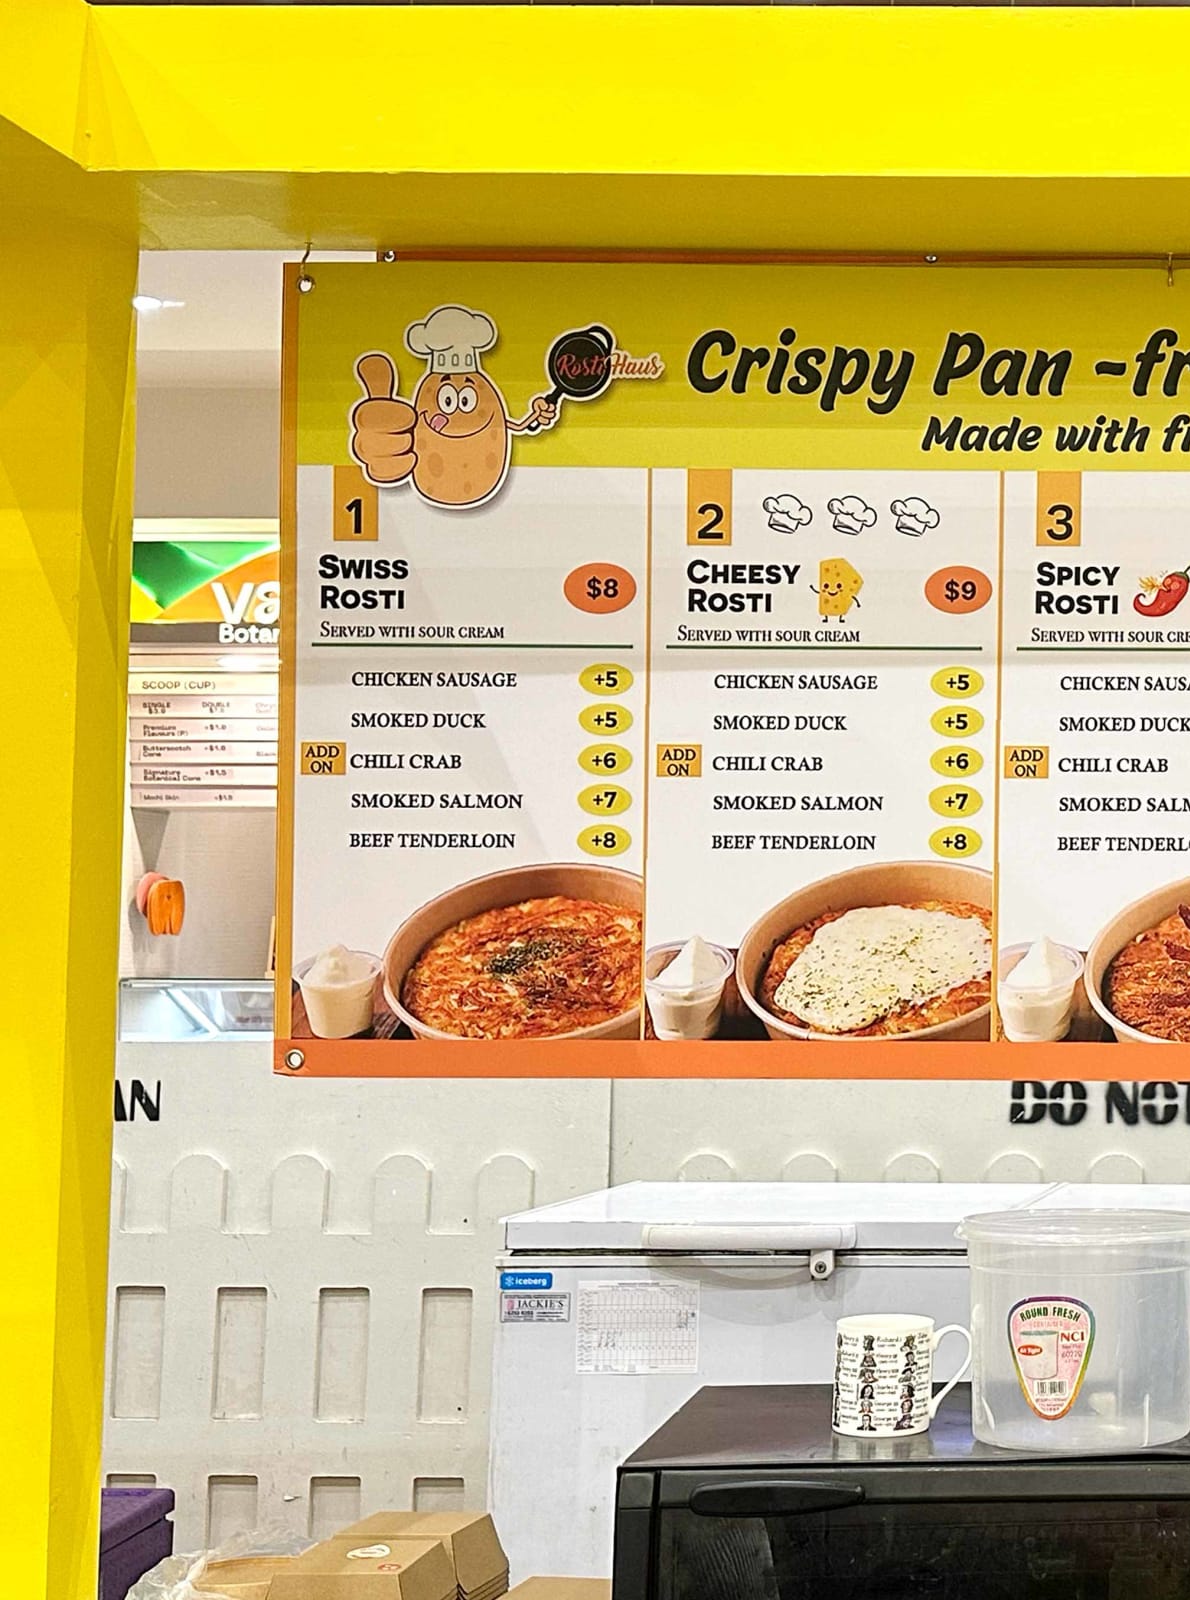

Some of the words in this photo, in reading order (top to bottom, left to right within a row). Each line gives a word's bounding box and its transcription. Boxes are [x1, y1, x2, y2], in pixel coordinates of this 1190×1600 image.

[688, 328, 914, 414] Crispy
[933, 332, 1072, 395] Pan
[922, 416, 1042, 451] Made
[1056, 416, 1147, 452] with
[346, 499, 361, 534] 1
[698, 504, 723, 539] 2
[1047, 505, 1072, 540] 3
[319, 555, 408, 579] SWISS
[687, 560, 800, 584] CHEESY
[1037, 562, 1120, 586] SPICY
[586, 577, 619, 600] $8
[945, 579, 976, 602] $9
[321, 585, 404, 609] ROSTI
[688, 589, 771, 612] ROSTI
[1036, 591, 1118, 614] ROSTI
[142, 681, 181, 689] SCOOP
[352, 672, 432, 686] CHICKEN
[437, 672, 516, 687] SAUSAGE
[594, 671, 618, 687] +5
[715, 675, 794, 689] CHICKEN
[799, 675, 877, 689] SAUSAGE
[946, 674, 970, 691] +5
[1061, 676, 1140, 690] CHICKEN
[352, 713, 428, 727] SMOKED
[433, 714, 486, 728] DUCK
[594, 712, 617, 728] +5
[714, 716, 789, 730] SMOKED
[795, 716, 847, 730] DUCK
[944, 713, 968, 730] +5
[1060, 717, 1135, 731] SMOKED
[306, 746, 339, 758] ADD
[662, 749, 696, 760] ADD
[1010, 750, 1043, 761] ADD
[311, 761, 333, 773] ON
[350, 754, 404, 768] CHILI
[410, 754, 461, 768] CRAB
[592, 752, 616, 768] +6
[713, 756, 765, 770] CHILI
[771, 757, 822, 771] CRAB
[945, 753, 969, 769] +6
[1059, 758, 1111, 772] CHILI
[1117, 758, 1168, 772] CRAB
[667, 764, 689, 776] ON
[1014, 765, 1037, 777] ON
[352, 794, 434, 808] SMOKED
[440, 794, 522, 808] SALMON
[593, 791, 618, 808] +7
[714, 796, 795, 810] SMOKED
[801, 796, 883, 810] SALMON
[944, 793, 969, 809] +7
[1060, 798, 1141, 811] SMOKED
[350, 834, 394, 847] BEEF
[398, 834, 515, 848] TENDERLOIN
[591, 832, 616, 849] +8
[712, 836, 755, 849] BEEF
[760, 836, 875, 849] TENDERLOIN
[943, 833, 967, 850] +8
[1058, 837, 1101, 850] BEEF
[1010, 1081, 1087, 1125] DO
[515, 1277, 547, 1287] iceberg
[1020, 1307, 1048, 1322] ROUND
[1053, 1307, 1081, 1322] FRESH
